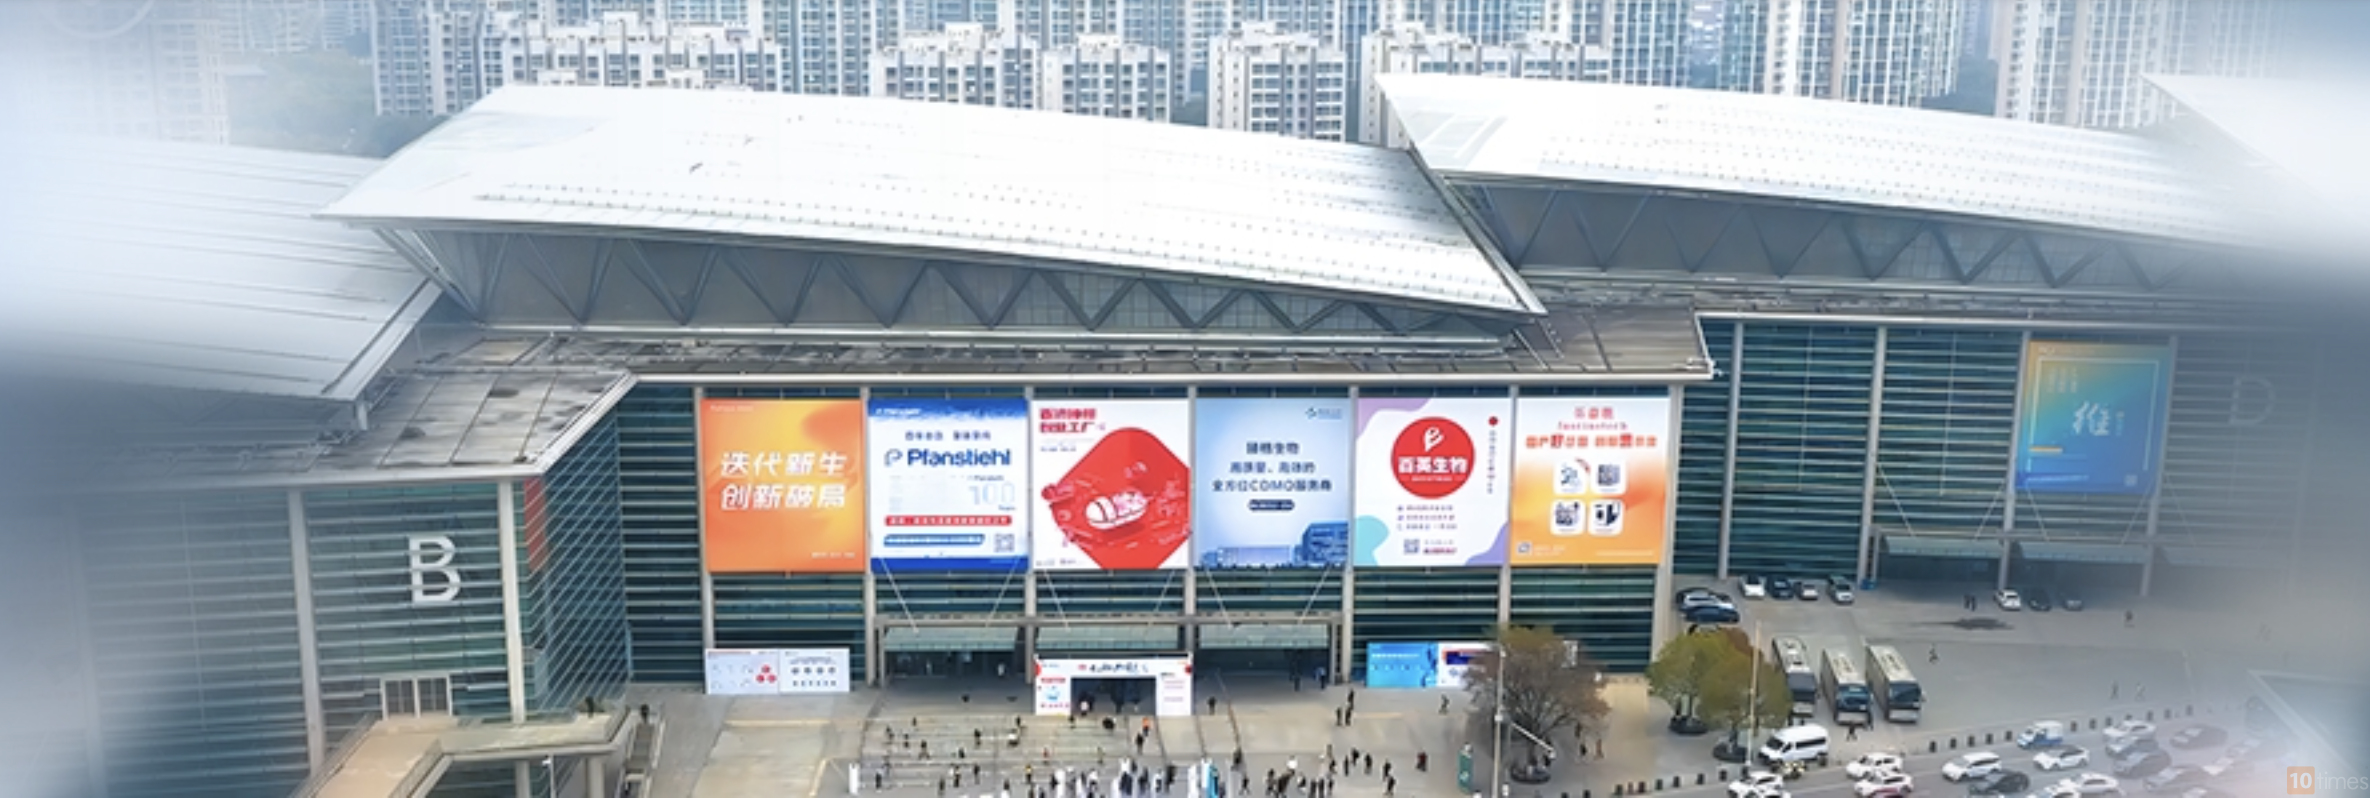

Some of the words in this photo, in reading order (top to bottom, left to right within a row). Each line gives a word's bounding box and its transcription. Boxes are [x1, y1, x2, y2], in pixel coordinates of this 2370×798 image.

[721, 451, 847, 477] 迭代新生
[906, 447, 1011, 467] Pfanstiehl
[1398, 456, 1468, 475] 百英生物
[720, 483, 845, 511] 创新破局
[407, 534, 461, 605] B
